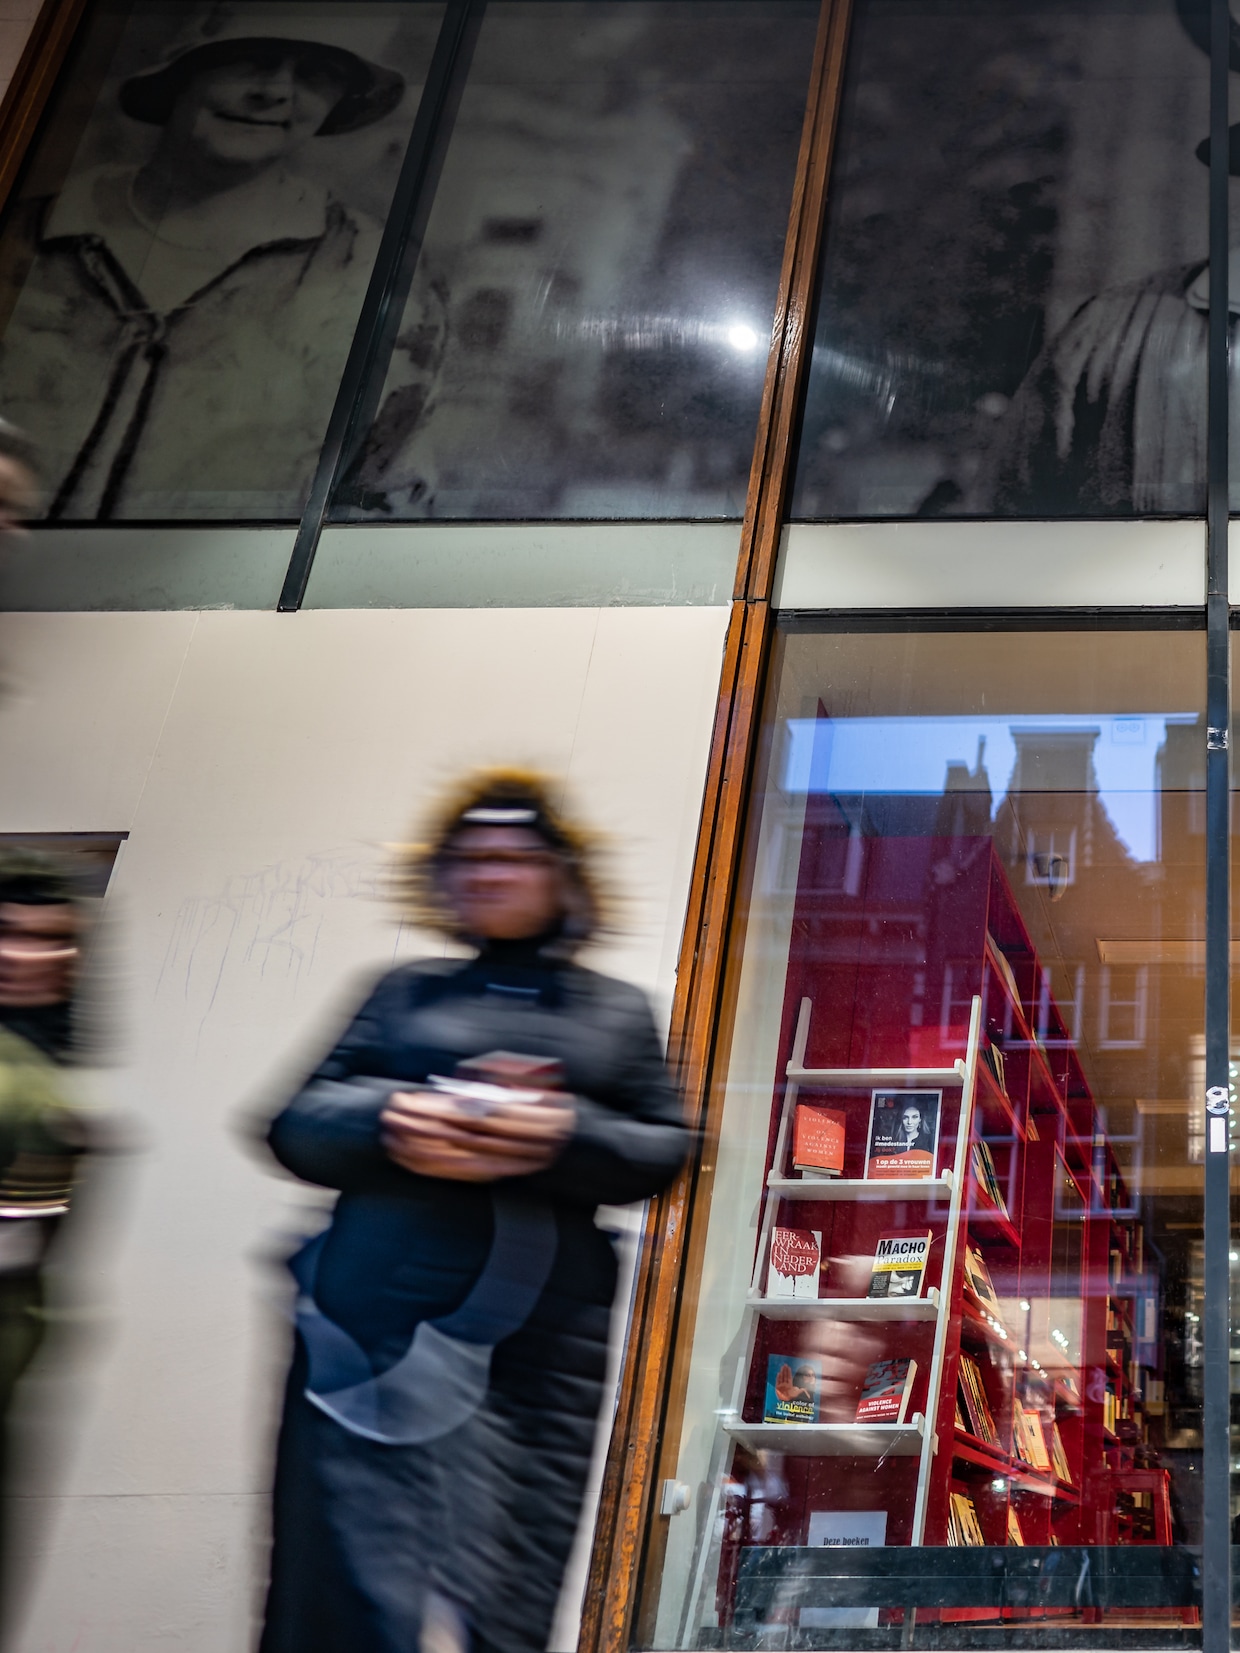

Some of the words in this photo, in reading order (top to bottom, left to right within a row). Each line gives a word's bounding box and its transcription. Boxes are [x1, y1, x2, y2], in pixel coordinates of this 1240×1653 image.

[802, 1134, 839, 1144] VIOLENCE
[805, 1141, 837, 1150] AGAINST
[806, 1147, 834, 1156] WOMEN
[880, 1159, 889, 1167] op
[776, 1230, 800, 1241] EER-
[775, 1238, 819, 1251] WRAAK
[878, 1240, 926, 1256] MACHO
[774, 1245, 790, 1255] IN
[774, 1254, 817, 1266] NEDER-
[877, 1254, 923, 1265] Paradox
[774, 1262, 807, 1273] LAND
[776, 1401, 814, 1414] violence
[868, 1398, 893, 1407] VIOLENCE
[858, 1405, 881, 1413] AGAINST
[880, 1403, 900, 1411] WOMEN
[823, 1536, 841, 1546] Deze
[842, 1536, 870, 1546] boeken
